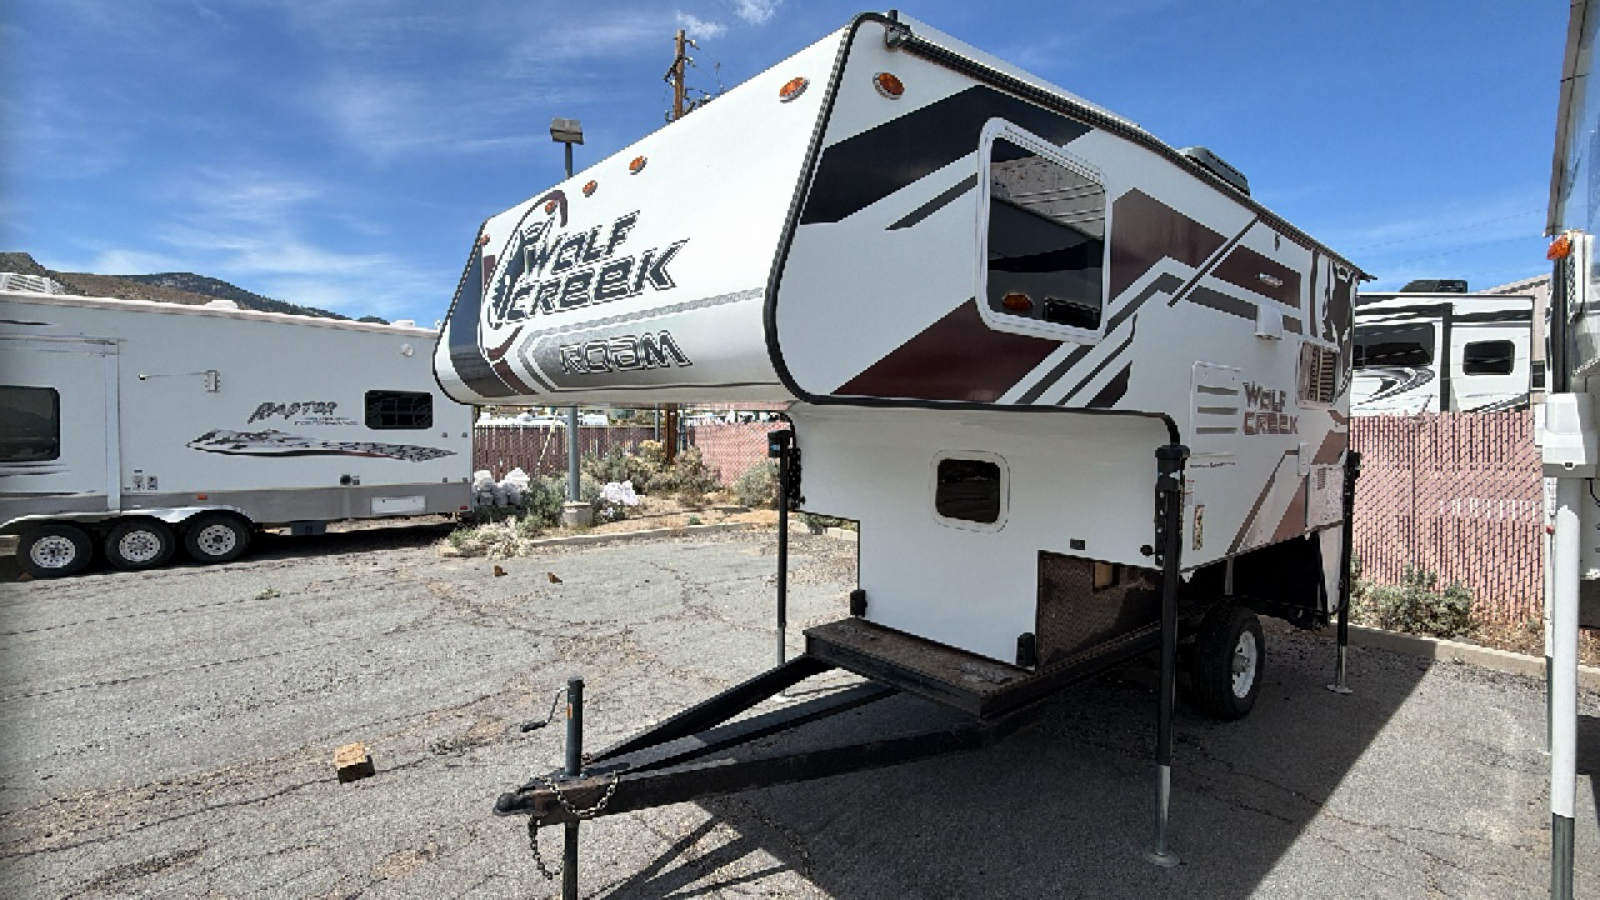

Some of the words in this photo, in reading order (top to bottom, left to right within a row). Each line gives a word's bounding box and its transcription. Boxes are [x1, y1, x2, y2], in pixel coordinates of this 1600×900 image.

[523, 210, 641, 281] WOLF
[505, 237, 691, 324] CREEK
[559, 330, 693, 375] ROAM
[247, 401, 338, 424] RAPTOR
[1242, 380, 1287, 412] WOLF
[1243, 410, 1300, 436] CREEK
